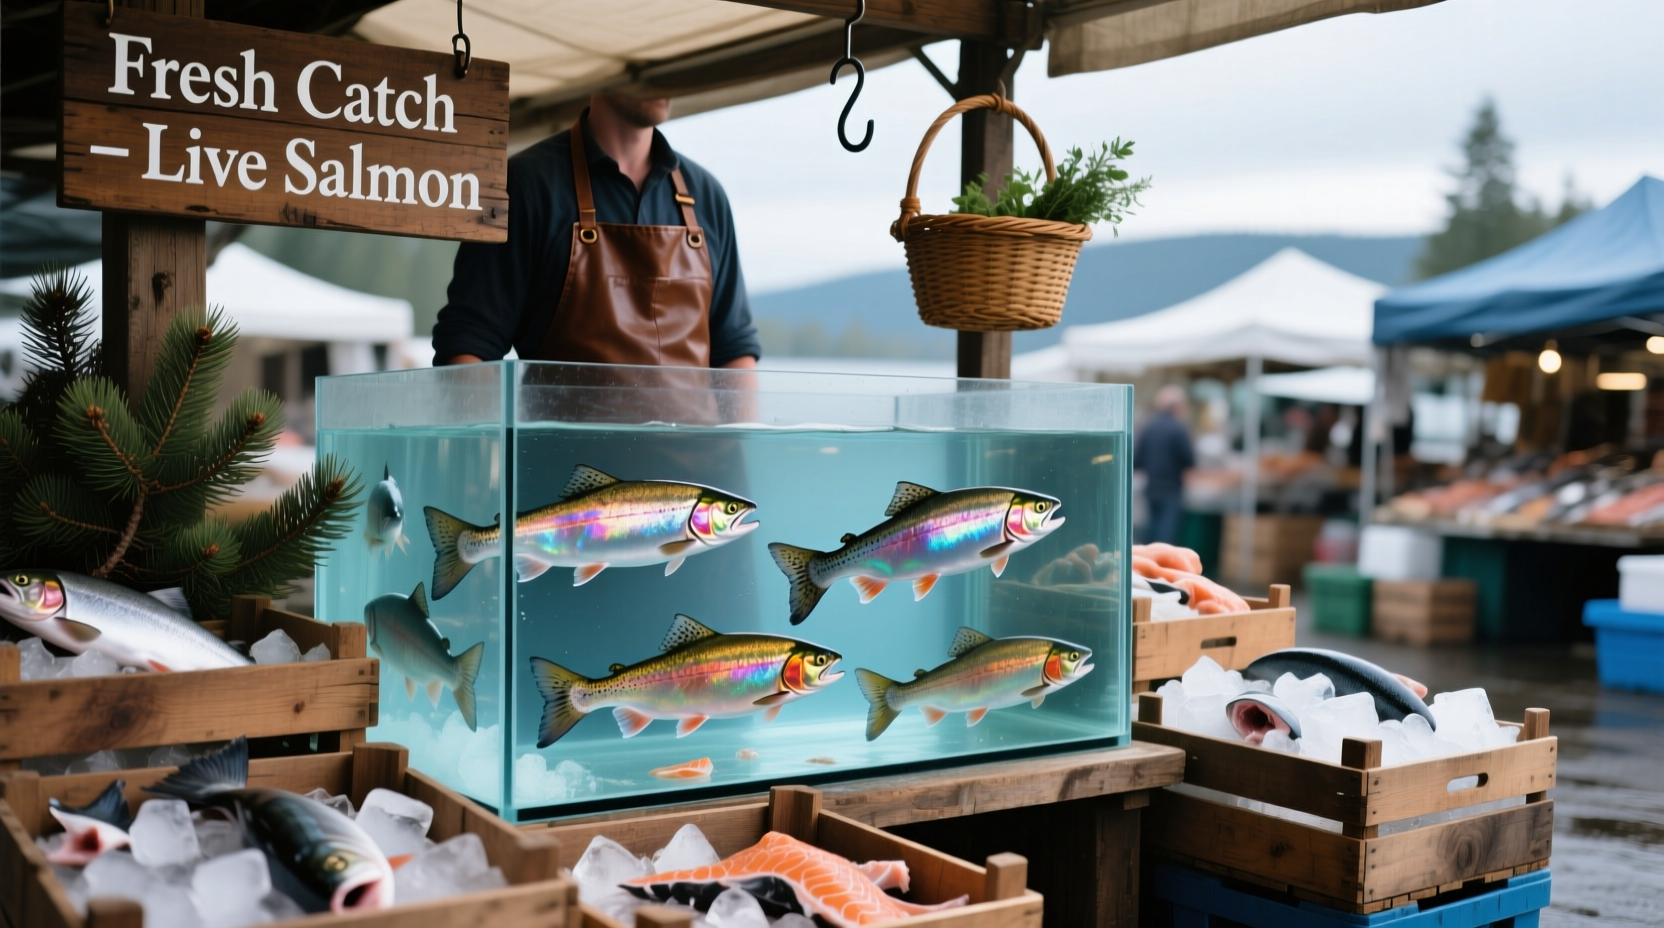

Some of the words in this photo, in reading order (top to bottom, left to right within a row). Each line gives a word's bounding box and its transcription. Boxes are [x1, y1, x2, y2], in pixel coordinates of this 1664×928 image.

[108, 32, 279, 113] Fresh
[297, 60, 458, 133] Catch
[141, 122, 267, 191] Live
[284, 137, 483, 211] Salmon
